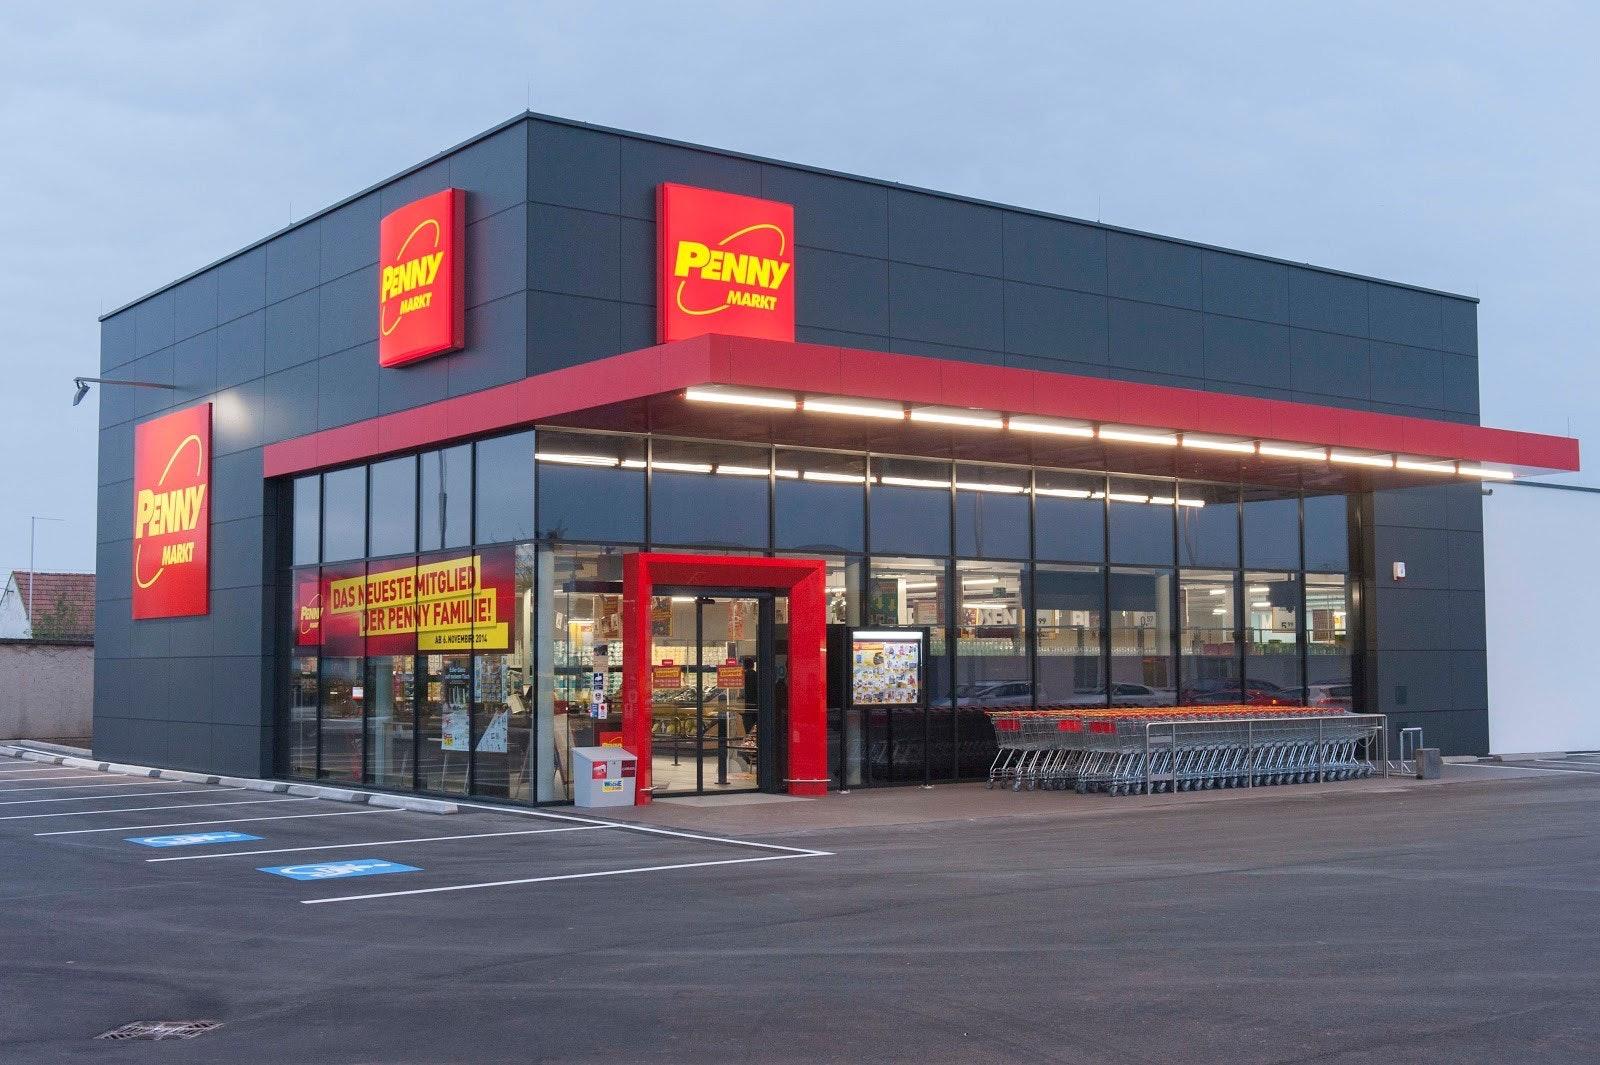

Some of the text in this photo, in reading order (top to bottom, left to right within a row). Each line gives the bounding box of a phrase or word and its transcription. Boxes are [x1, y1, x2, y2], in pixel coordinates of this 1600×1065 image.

[381, 251, 445, 304] PENNY
[674, 240, 790, 290] PENNY
[399, 291, 432, 315] MARKT
[726, 290, 777, 311] MARKT
[135, 484, 206, 539] PENNY
[162, 542, 195, 566] MARKT
[333, 565, 477, 610] DAS NEUESTE MITGLIED
[364, 597, 492, 632] DER PENNY FAMILIE!
